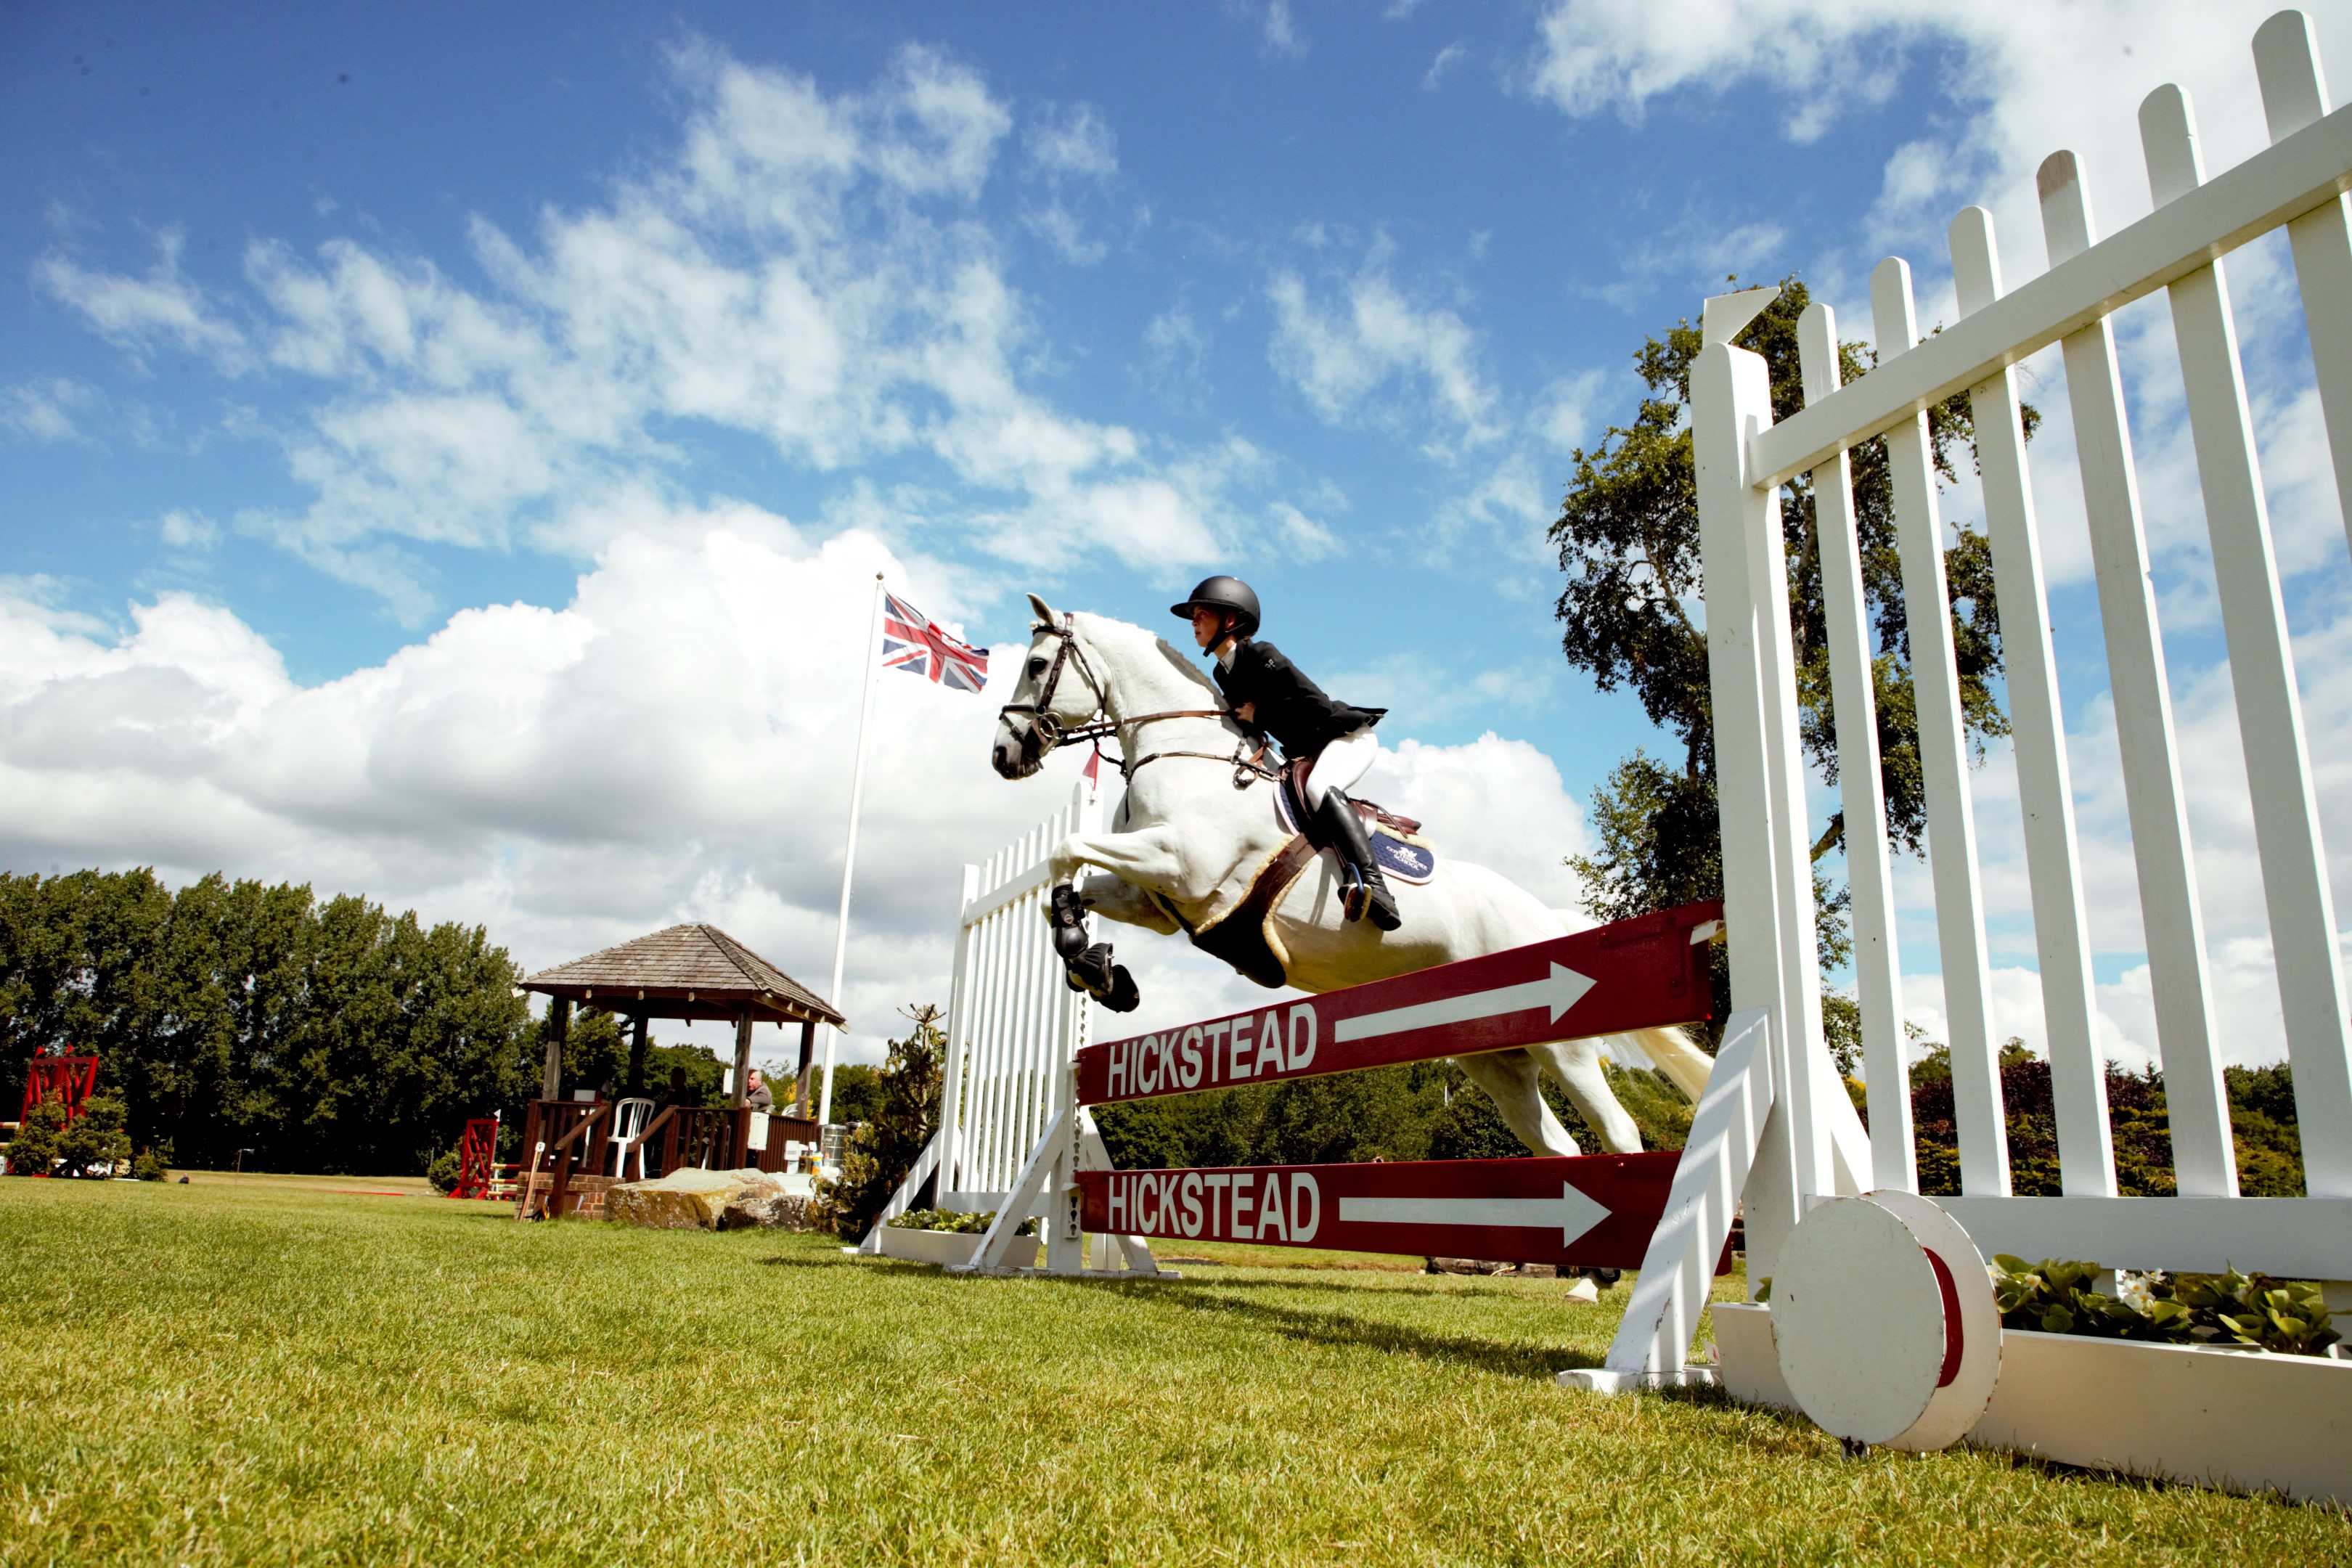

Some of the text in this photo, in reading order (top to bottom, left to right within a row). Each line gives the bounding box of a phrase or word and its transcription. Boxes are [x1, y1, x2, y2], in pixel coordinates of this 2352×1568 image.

[1394, 854, 1419, 871] SCHOOL
[1108, 1003, 1318, 1098] HICKSTEAD
[1108, 1172, 1320, 1243] HICKSTEAD
